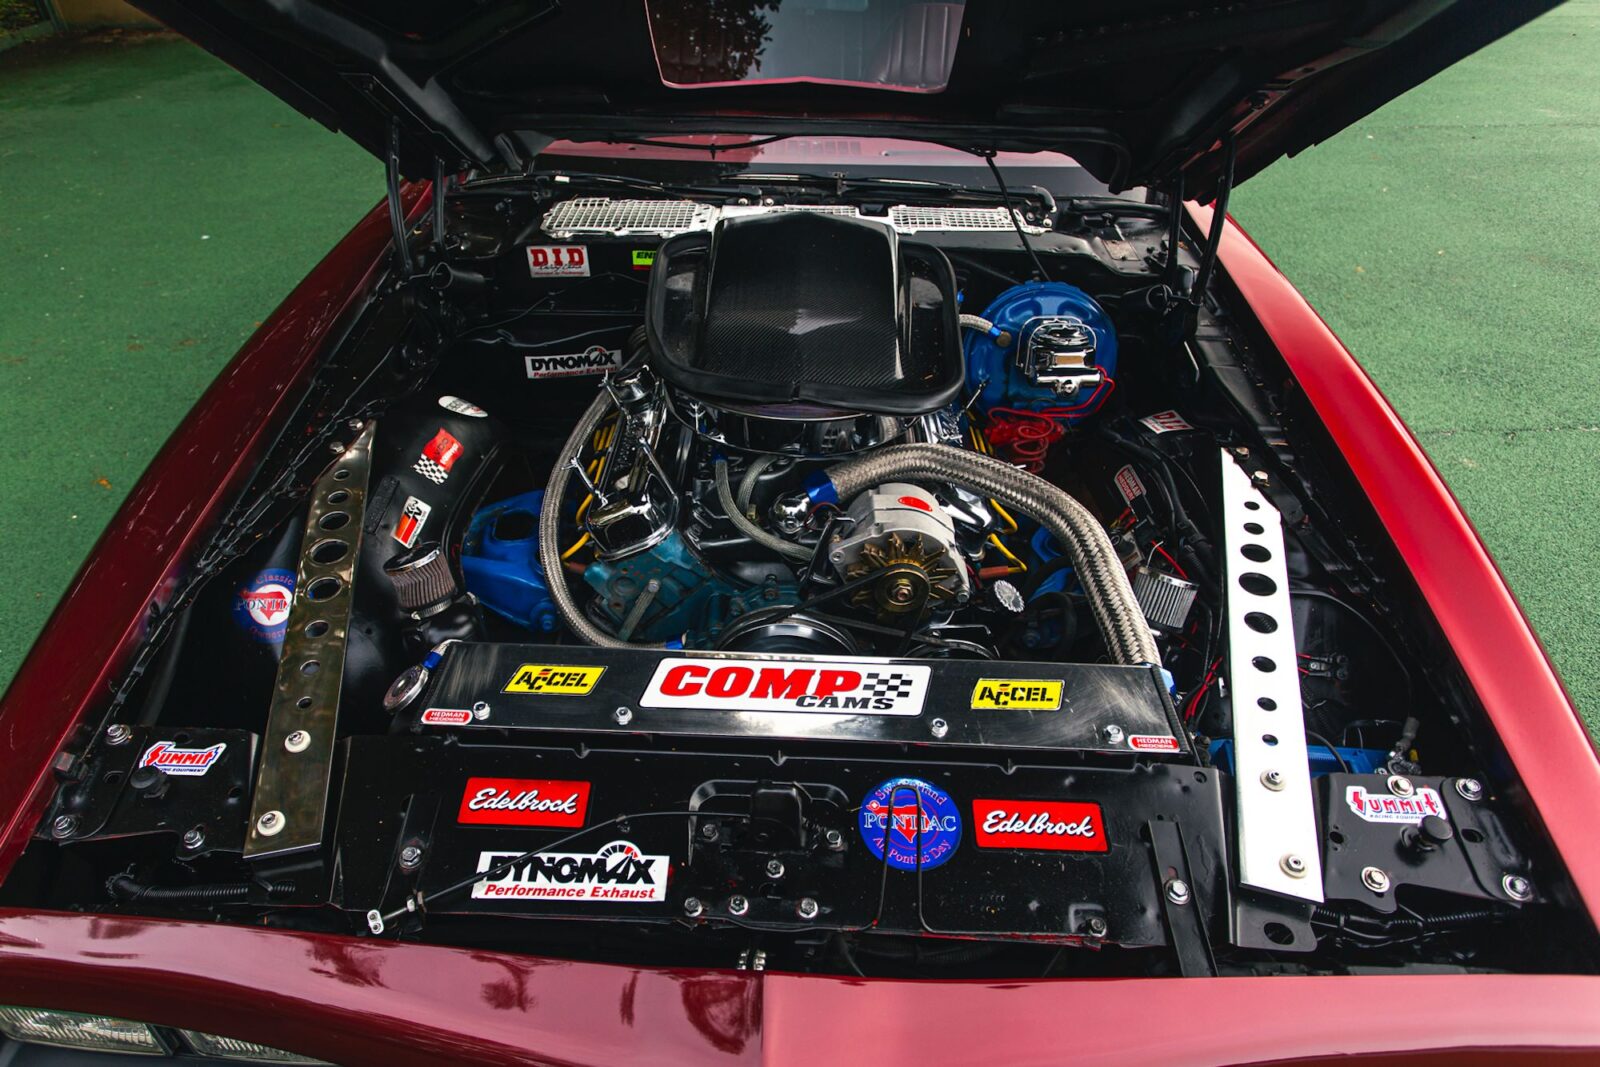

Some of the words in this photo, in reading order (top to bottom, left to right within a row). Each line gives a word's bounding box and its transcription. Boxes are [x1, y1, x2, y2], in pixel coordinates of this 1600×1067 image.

[530, 352, 617, 371] DYNOMAX
[533, 370, 584, 378] Performance
[256, 574, 294, 586] Classic
[233, 598, 292, 611] PONTI
[514, 668, 589, 690] ACCEL
[659, 664, 862, 700] COMP
[795, 695, 894, 710] CAMS
[978, 683, 1054, 706] ACCEL
[468, 787, 579, 815] Edelbrock
[863, 811, 957, 832] PONTIAC
[982, 809, 1095, 838] Edelbrock
[929, 839, 952, 859] Day
[486, 853, 656, 885] DYNOMAX
[484, 884, 586, 898] Performance
[590, 886, 655, 899] Exhaust
